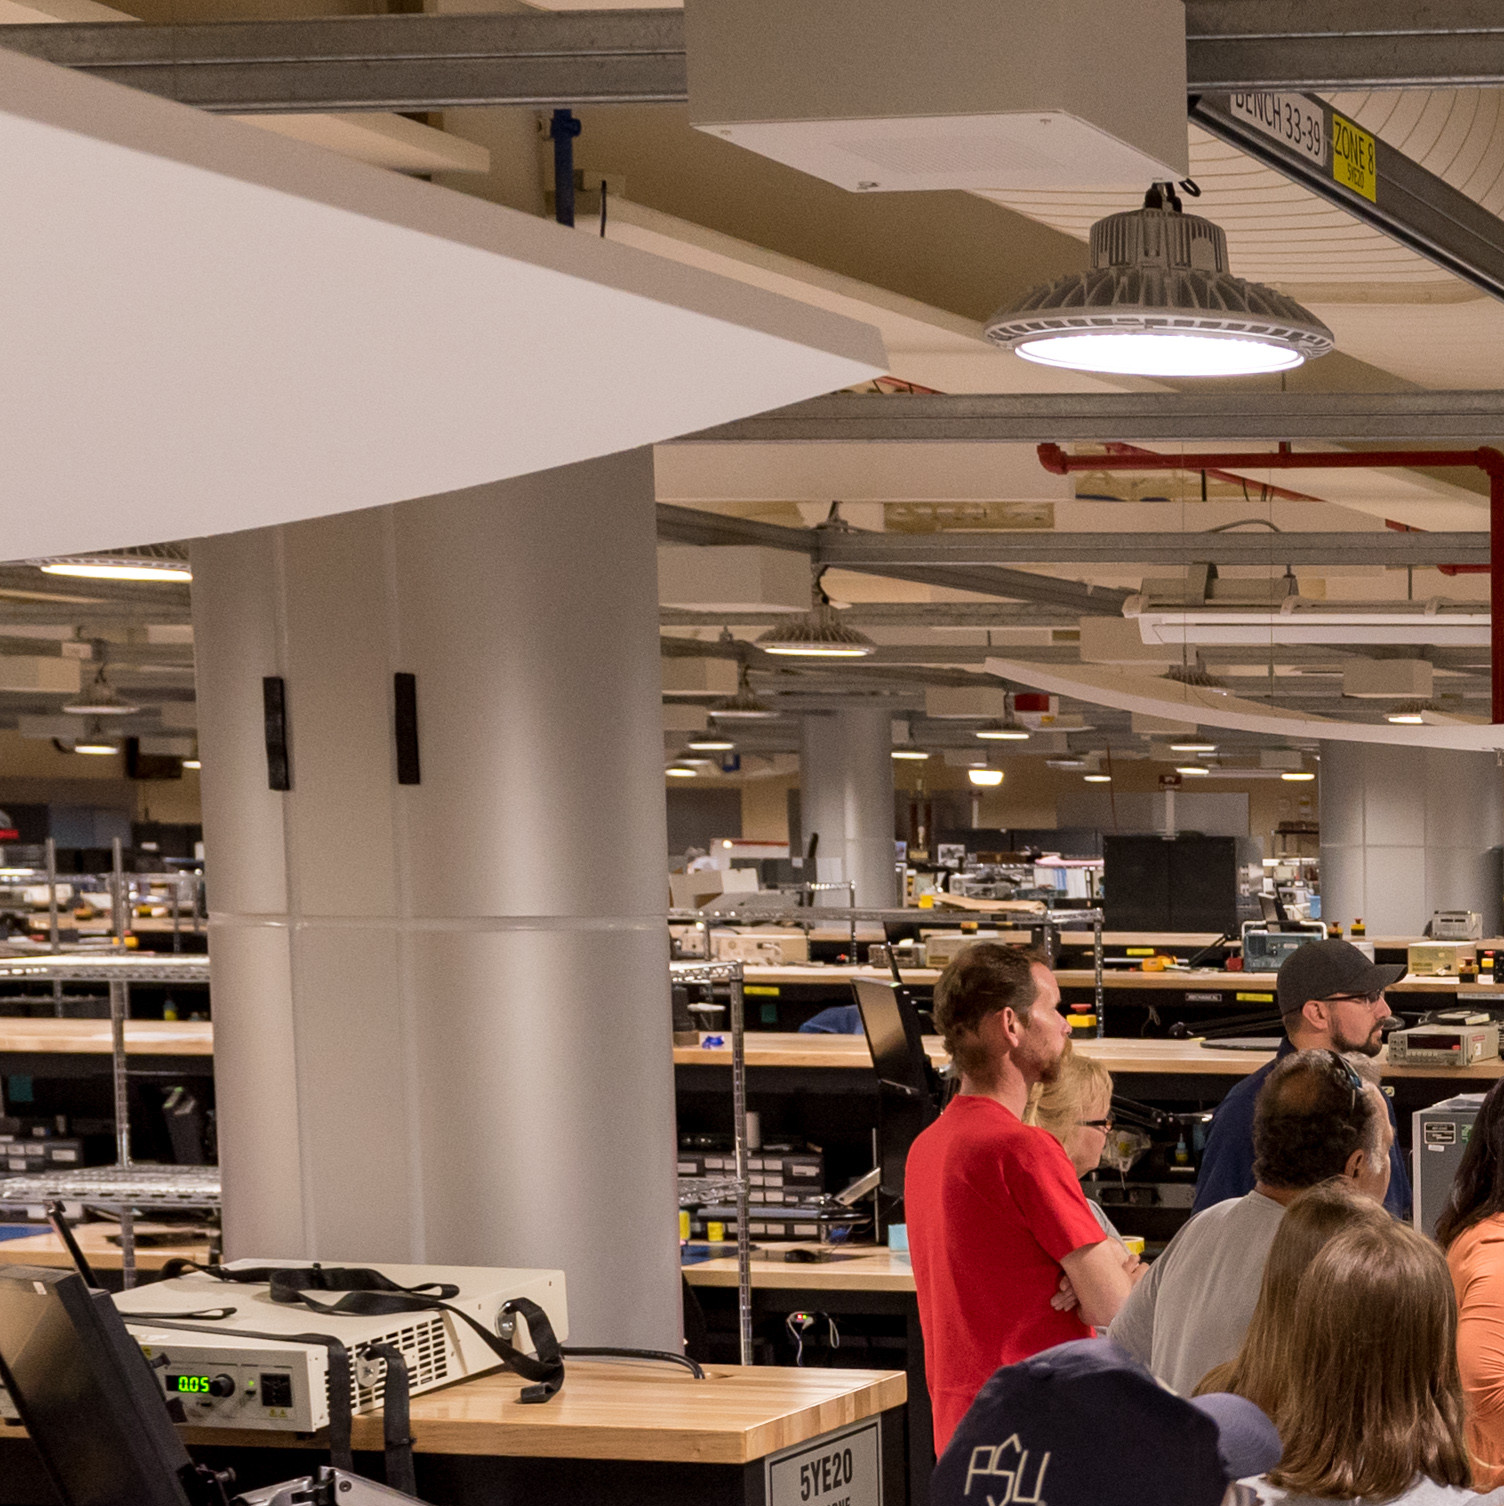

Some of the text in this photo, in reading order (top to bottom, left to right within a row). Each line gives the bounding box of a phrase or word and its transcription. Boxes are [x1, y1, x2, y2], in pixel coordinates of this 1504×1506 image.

[1285, 102, 1321, 156] 33-39
[1335, 121, 1374, 175] ZONE 8
[800, 1448, 853, 1502] 5YE20
